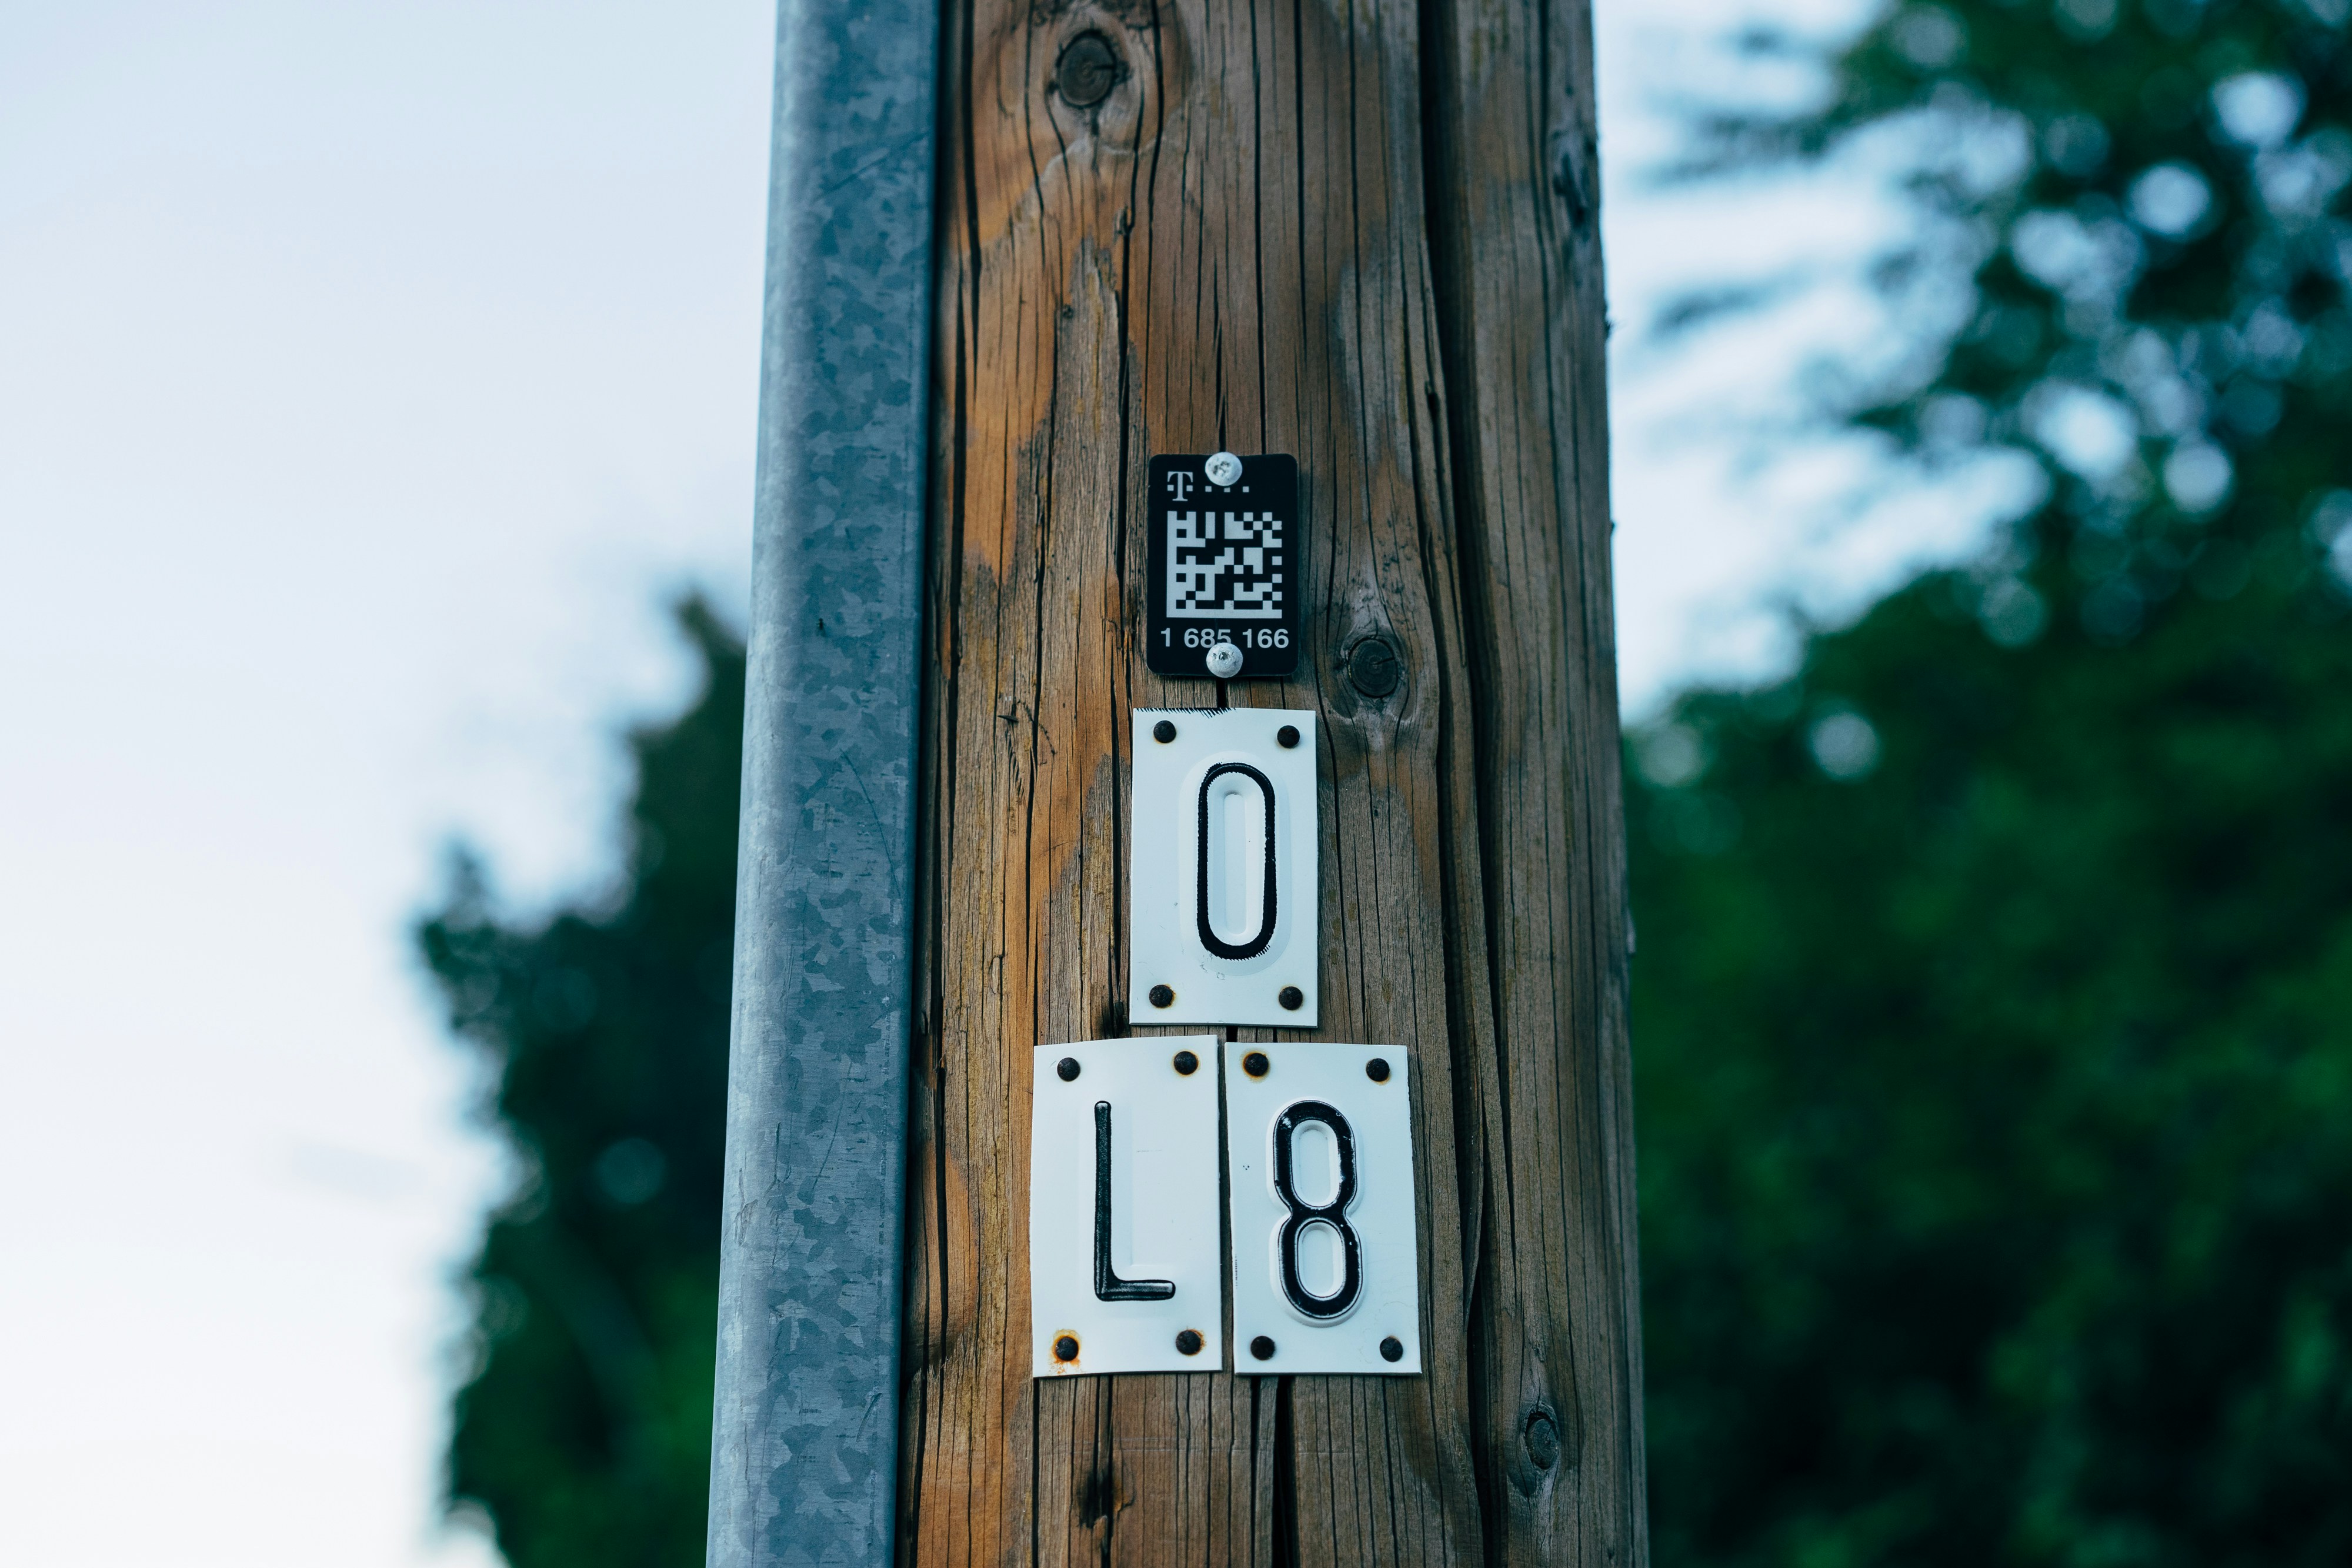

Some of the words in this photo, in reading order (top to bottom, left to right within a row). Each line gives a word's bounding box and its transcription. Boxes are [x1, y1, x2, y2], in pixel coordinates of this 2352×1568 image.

[1167, 471, 1193, 501] T
[1160, 628, 1171, 647] 1
[1184, 628, 1232, 648] 685
[1242, 628, 1289, 648] 166
[1093, 1100, 1176, 1302] L
[1273, 1099, 1364, 1319] 8
